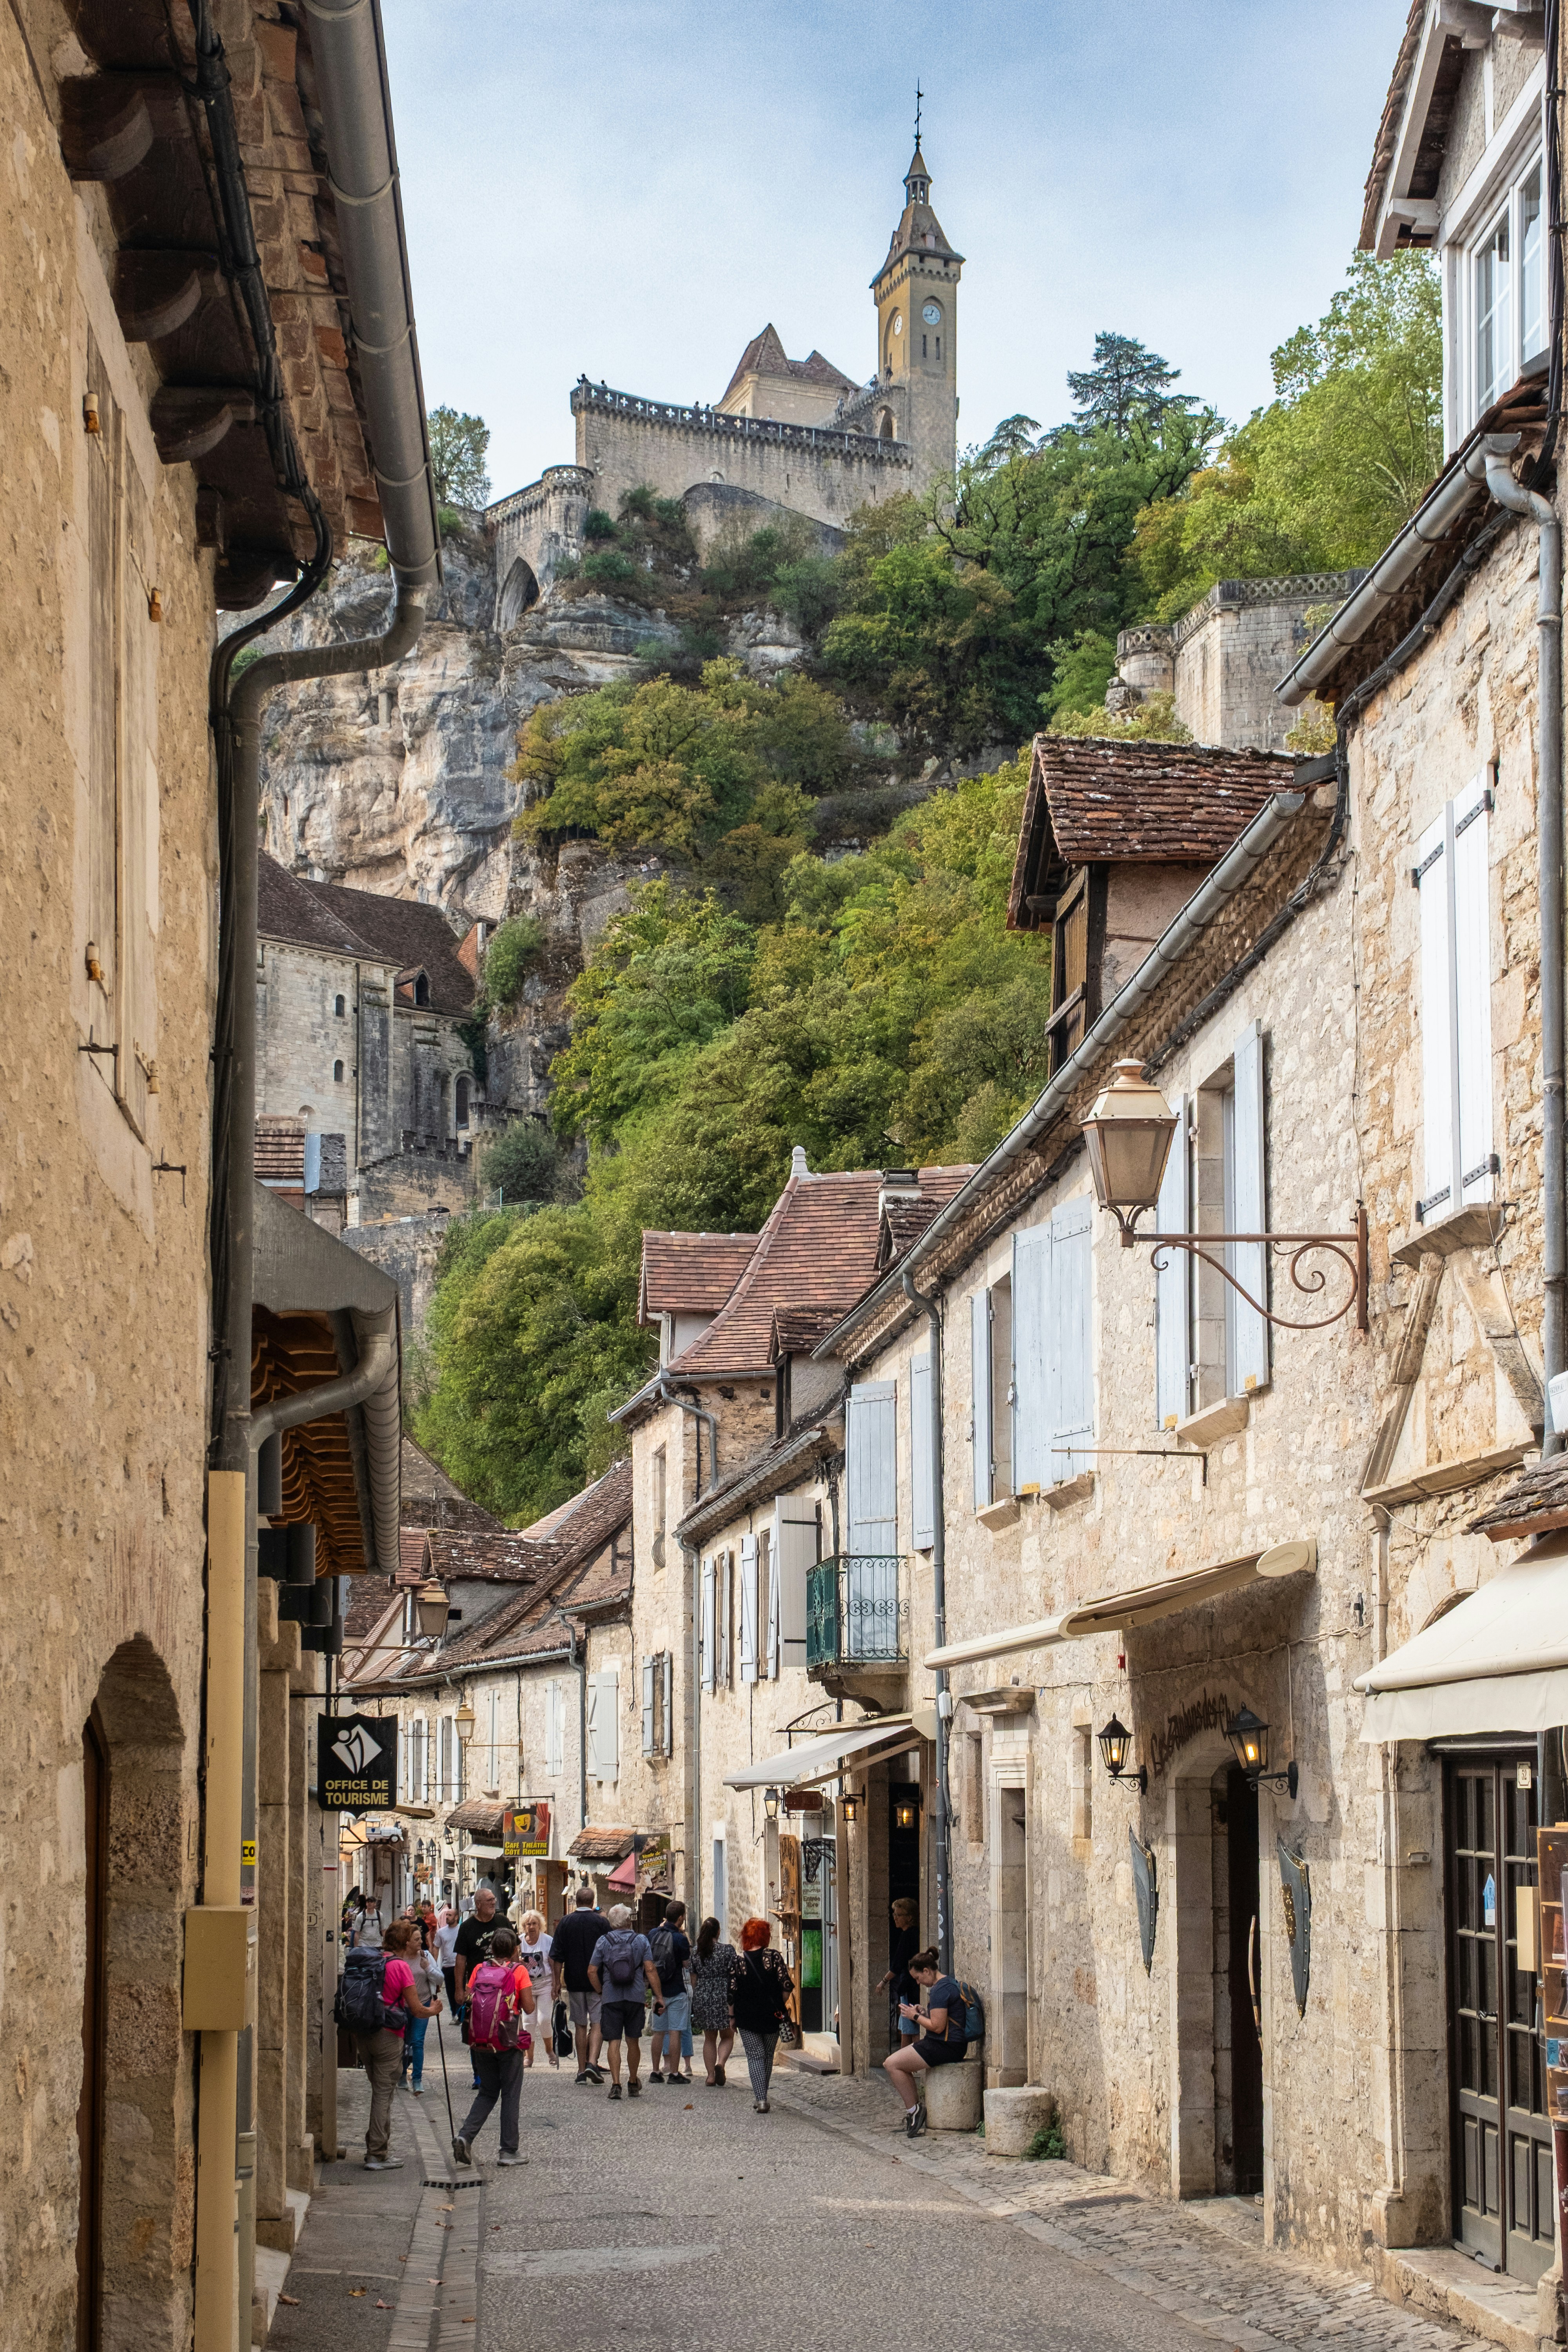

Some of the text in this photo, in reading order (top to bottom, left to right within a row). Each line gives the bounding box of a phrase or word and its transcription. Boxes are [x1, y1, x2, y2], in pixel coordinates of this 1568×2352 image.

[1522, 1769, 1527, 1780] 52
[325, 1780, 389, 1789] OFFICE DE
[325, 1792, 389, 1805] TOURISME
[639, 1854, 667, 1866] ROCAMADOUR
